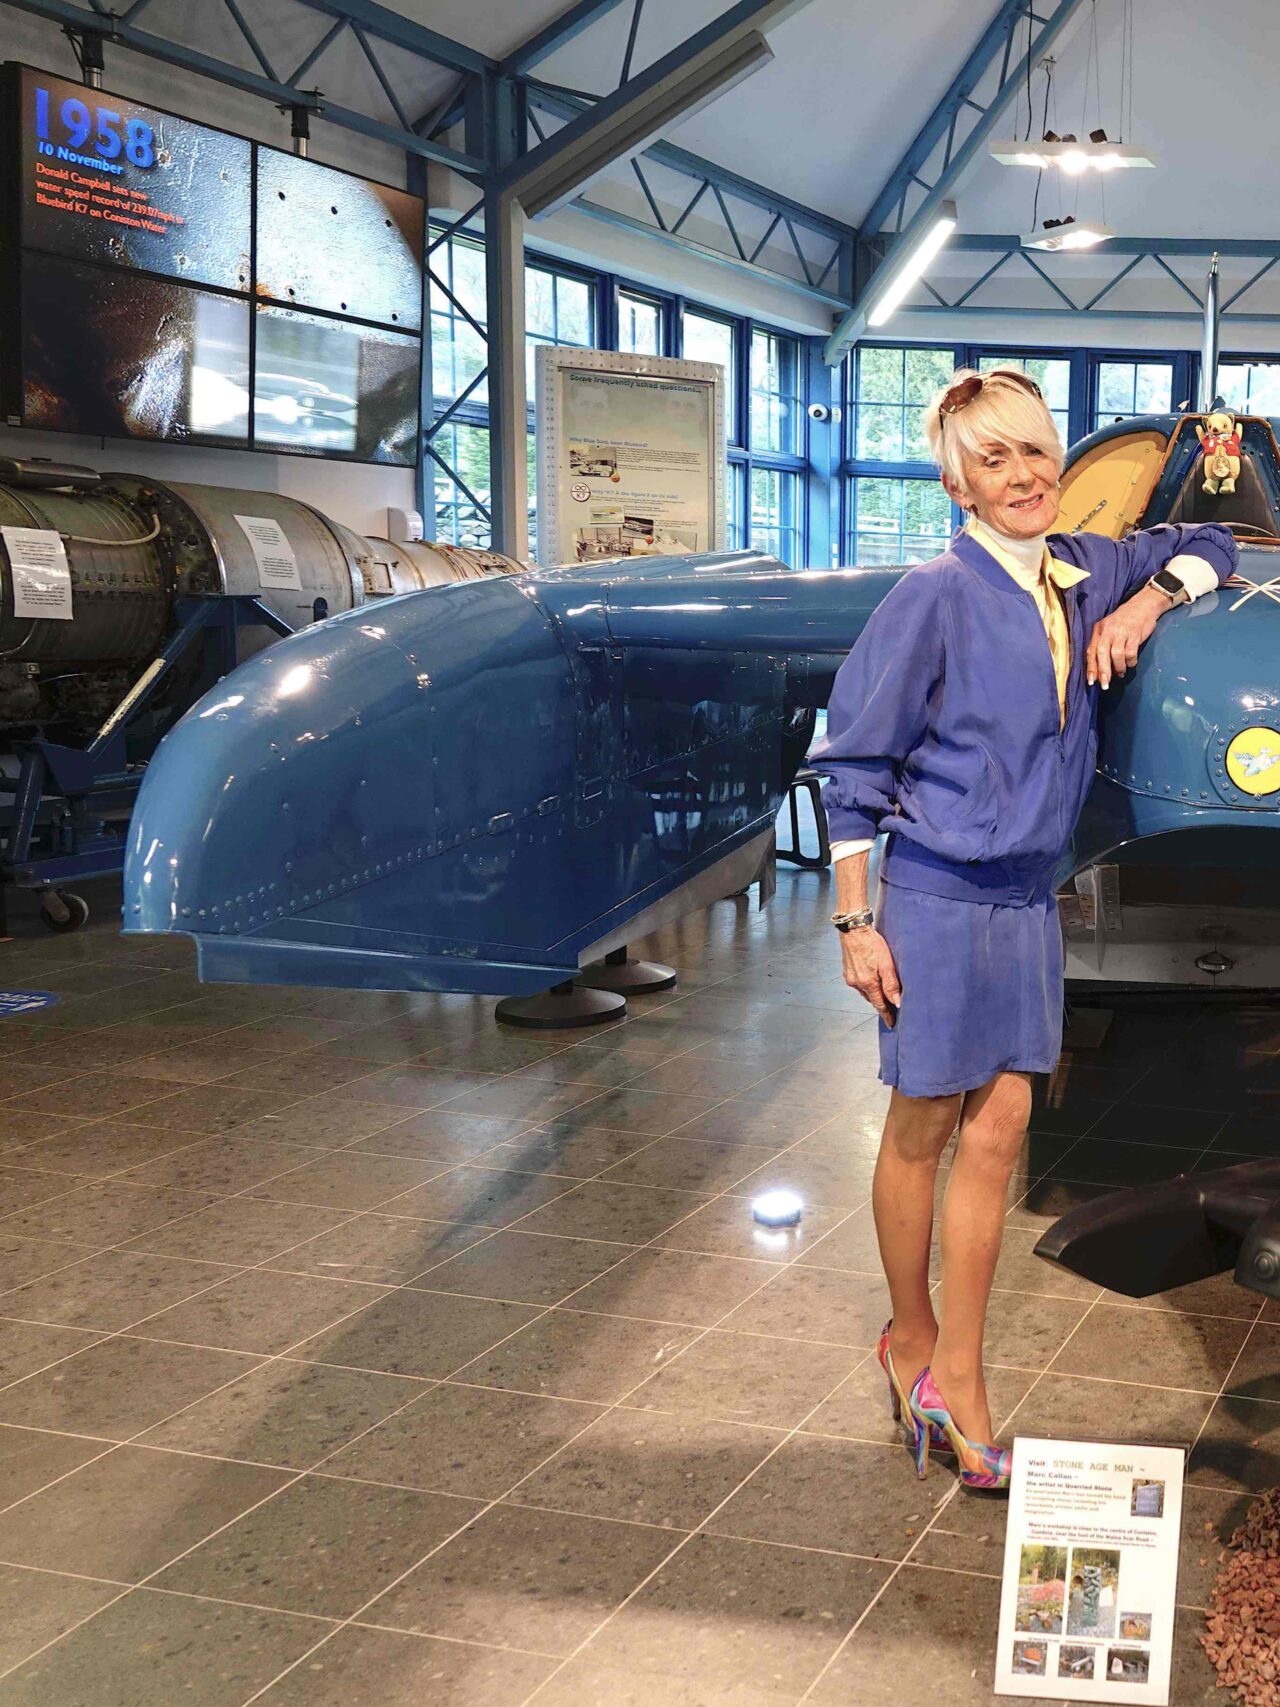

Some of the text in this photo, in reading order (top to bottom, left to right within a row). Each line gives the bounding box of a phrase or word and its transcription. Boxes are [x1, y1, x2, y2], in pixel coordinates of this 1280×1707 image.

[35, 88, 154, 168] 1958
[38, 141, 124, 175] 10 November
[36, 163, 69, 180] Donald
[71, 171, 110, 191] Campbell
[112, 185, 129, 197] sets
[36, 180, 62, 192] water
[64, 186, 90, 201] speed
[92, 193, 120, 208] record
[121, 200, 130, 210] of
[36, 192, 73, 211] Bluebird
[75, 202, 88, 214] K7
[89, 209, 101, 219] on
[103, 210, 141, 228] Coniston
[569, 374, 591, 383] Some
[1028, 1459, 1133, 1472] Visit STONE AGE MAN
